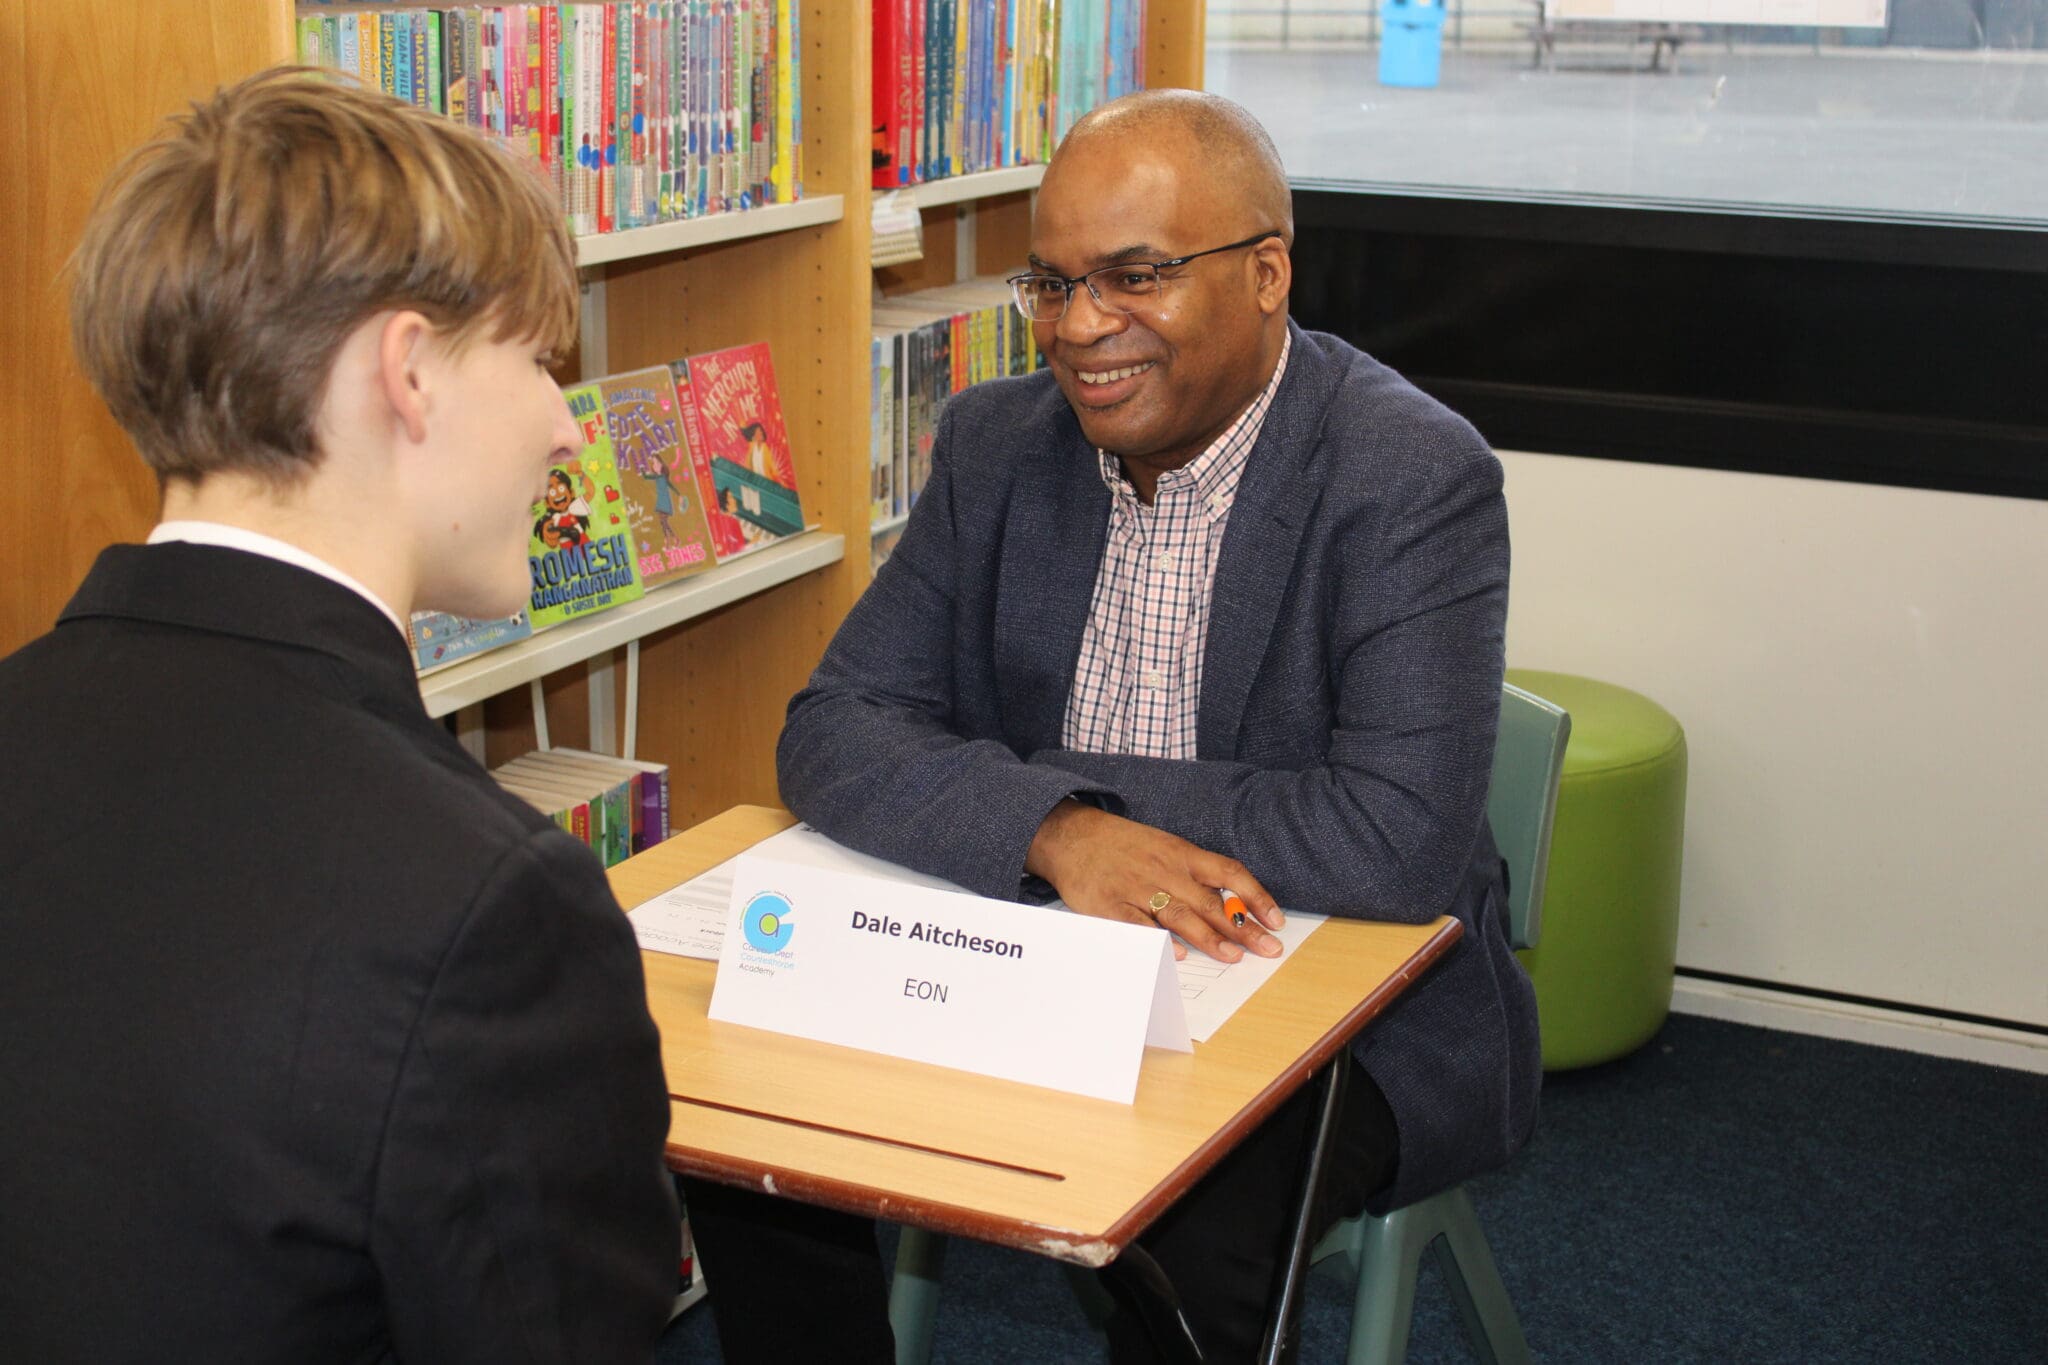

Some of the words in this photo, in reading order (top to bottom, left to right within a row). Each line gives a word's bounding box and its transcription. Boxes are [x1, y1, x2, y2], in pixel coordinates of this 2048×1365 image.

[383, 22, 394, 96] HAPPYTOW
[415, 33, 425, 85] HARRY
[702, 355, 721, 382] THE
[701, 360, 760, 429] MERCURY
[617, 419, 678, 477] KHART
[529, 533, 630, 590] ROMESH
[638, 555, 664, 577] SIE
[665, 543, 706, 568] JONES
[532, 565, 634, 611] RANGANATHAN
[851, 911, 901, 937] Dale
[908, 922, 1023, 959] Aitcheson
[739, 963, 776, 976] Academy
[904, 978, 948, 1003] EON
